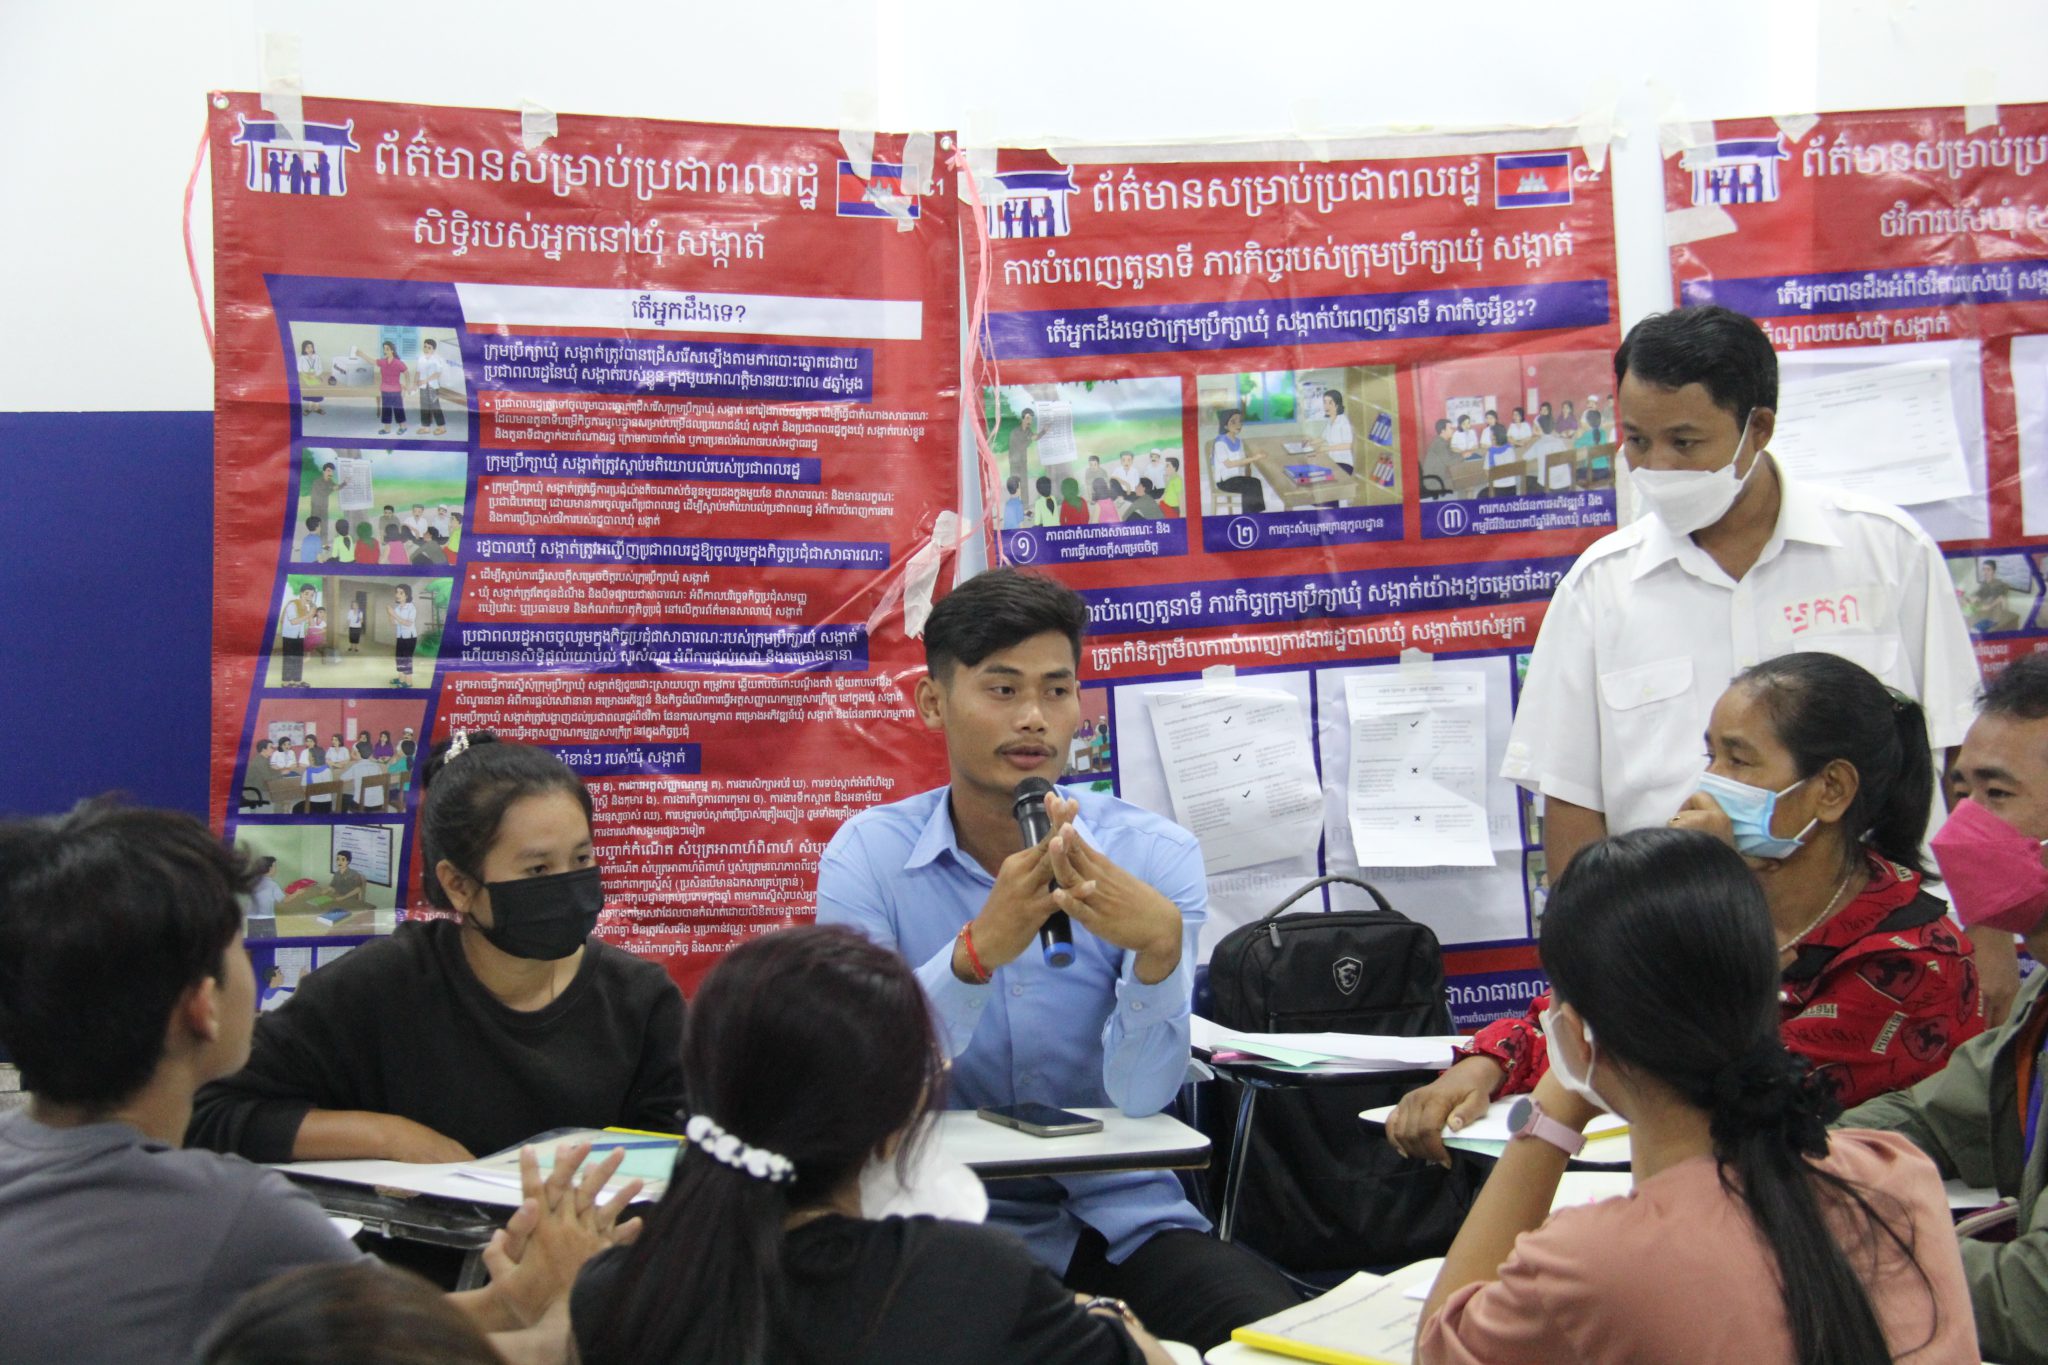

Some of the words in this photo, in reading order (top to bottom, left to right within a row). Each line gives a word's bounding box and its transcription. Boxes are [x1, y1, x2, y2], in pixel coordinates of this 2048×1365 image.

[375, 131, 818, 210] ព័ត៌មានសម្រាប់ប្រជាពលរដ្ឋ
[1093, 162, 1482, 217] ព័ត៌មានសម្រាប់ប្រជាពលរដ្ឋ
[414, 208, 665, 265] សិទ្ធិរបស់អ្នកនៅឃុំ
[677, 223, 766, 268] សង្កាត់
[1003, 242, 1194, 290] ការបំពេញតួនាទី
[1203, 226, 1485, 281] ភារកិច្ចរបស់ក្រុមប្រឹក្សាឃុំ
[1493, 223, 1574, 269] សង្កាត់
[631, 297, 746, 327] តើអ្នកដឹងទេ?
[1893, 310, 1951, 342] សង្កាត់
[483, 340, 559, 365] ក្រុមប្រឹក្សាឃុំ
[485, 451, 559, 473] ក្រុមប្រឹក្សាឃុំ
[476, 537, 536, 558] រដ្ឋបាលឃុំ
[820, 627, 858, 651] សង្កាត់
[604, 747, 646, 767] របស់ឃុំ
[647, 747, 686, 771] សង្កាត់
